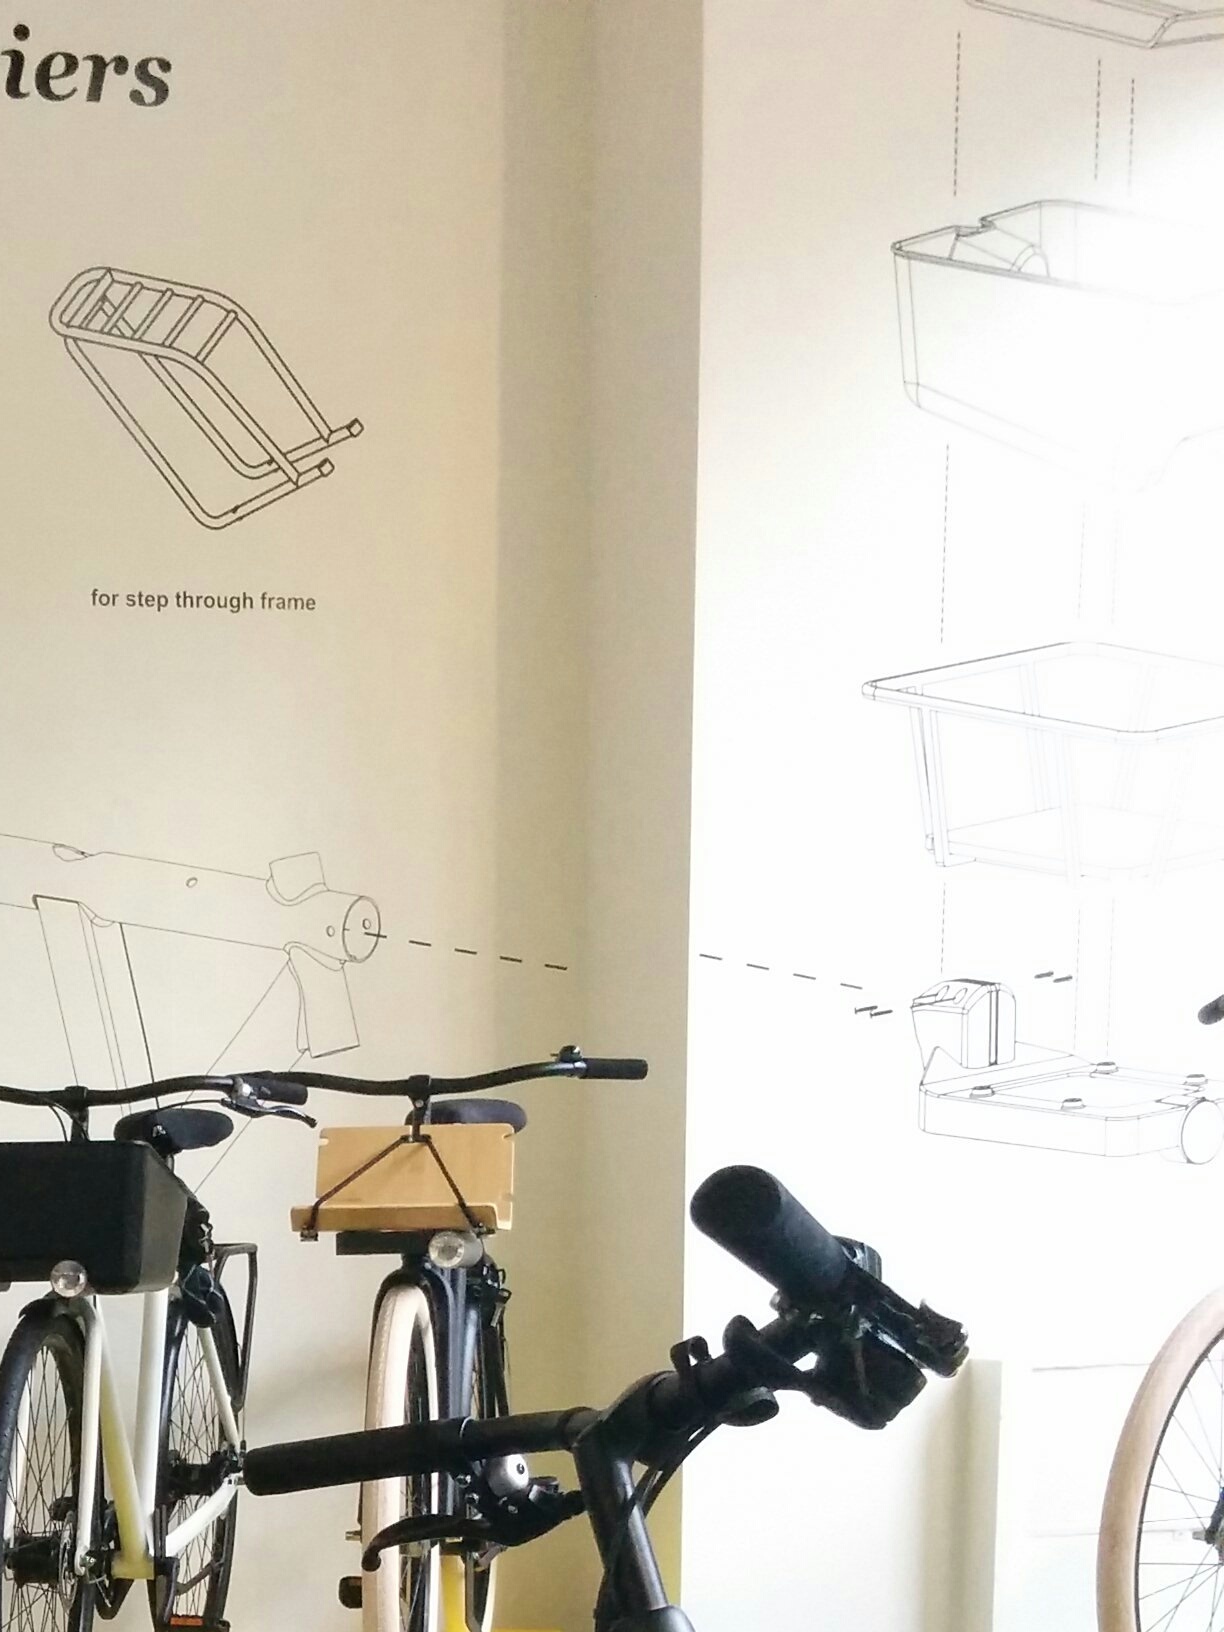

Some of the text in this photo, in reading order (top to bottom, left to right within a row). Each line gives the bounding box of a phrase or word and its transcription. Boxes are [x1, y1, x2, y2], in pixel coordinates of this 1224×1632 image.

[91, 588, 316, 613] for step through frame
